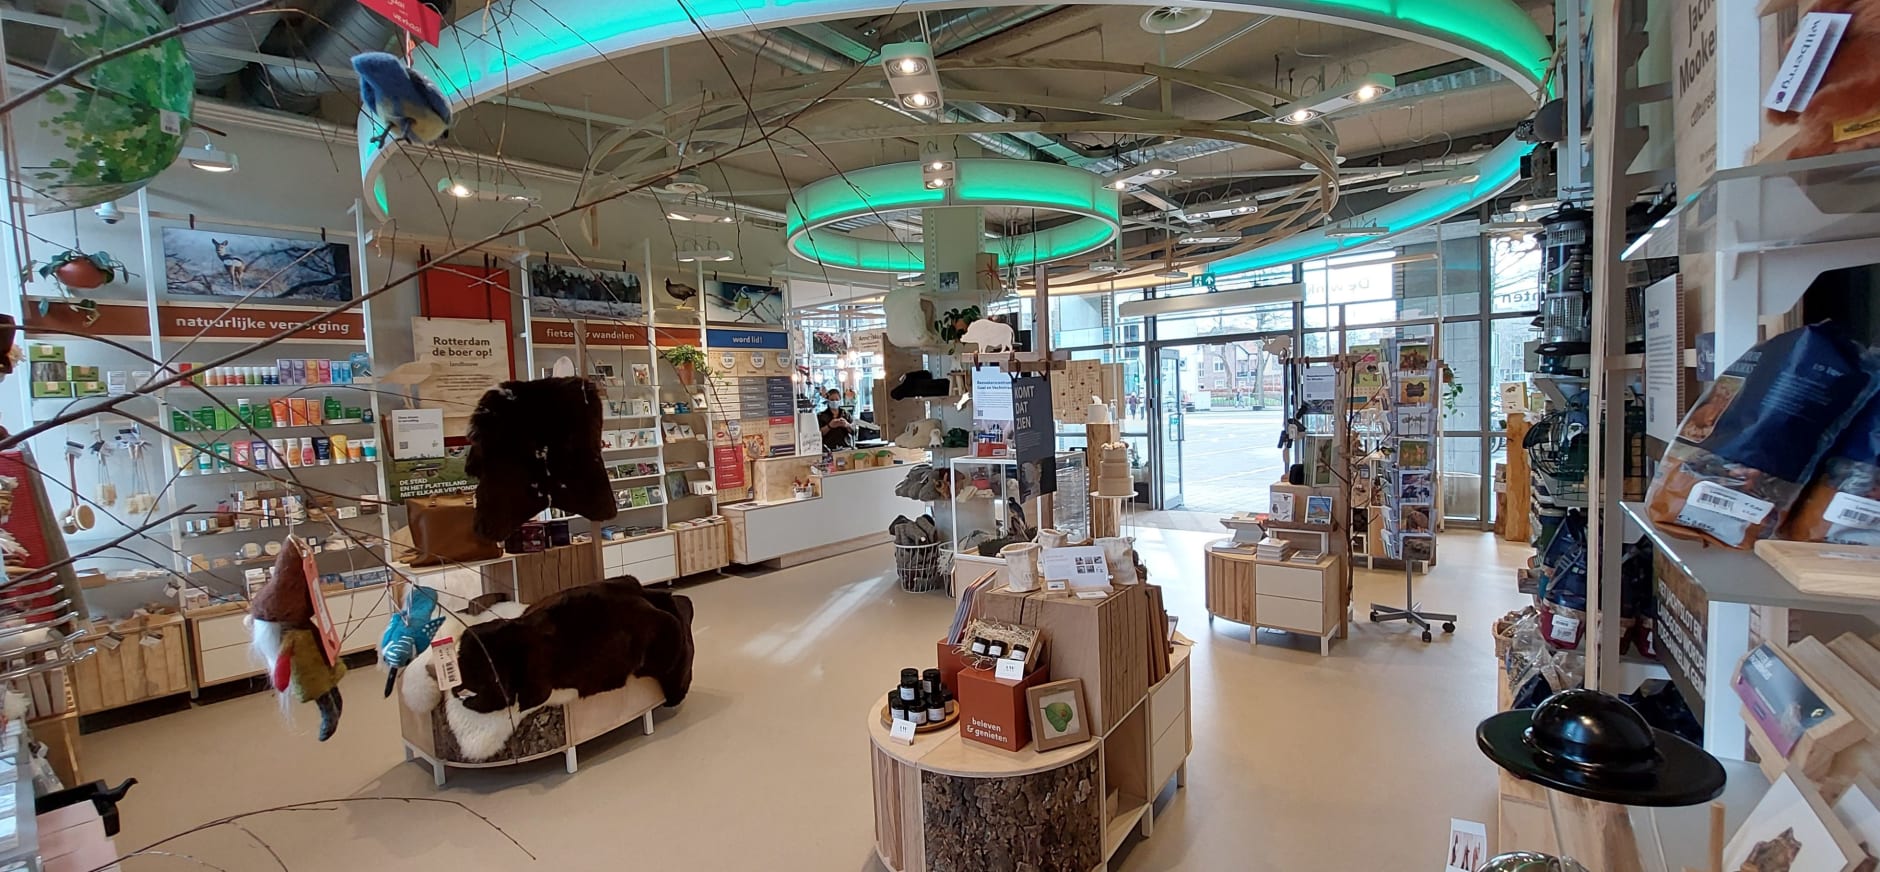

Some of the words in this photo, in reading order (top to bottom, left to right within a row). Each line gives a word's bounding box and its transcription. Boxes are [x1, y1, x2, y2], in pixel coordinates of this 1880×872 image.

[175, 316, 266, 331] natuurlijke
[433, 336, 490, 346] Rotterdam
[546, 328, 574, 338] fietse
[592, 331, 635, 340] wandelen
[432, 347, 446, 357] de
[448, 347, 473, 357] boer
[475, 348, 493, 359] op!
[1014, 385, 1035, 399] KOMT
[1015, 401, 1028, 415] DAT
[1016, 415, 1032, 430] ZIEN
[425, 479, 468, 489] PLATTELAND
[400, 491, 416, 499] MET
[416, 488, 443, 496] ELKAAR
[972, 716, 1001, 732] beleven
[967, 725, 974, 733] &
[975, 729, 1008, 743] genieten
